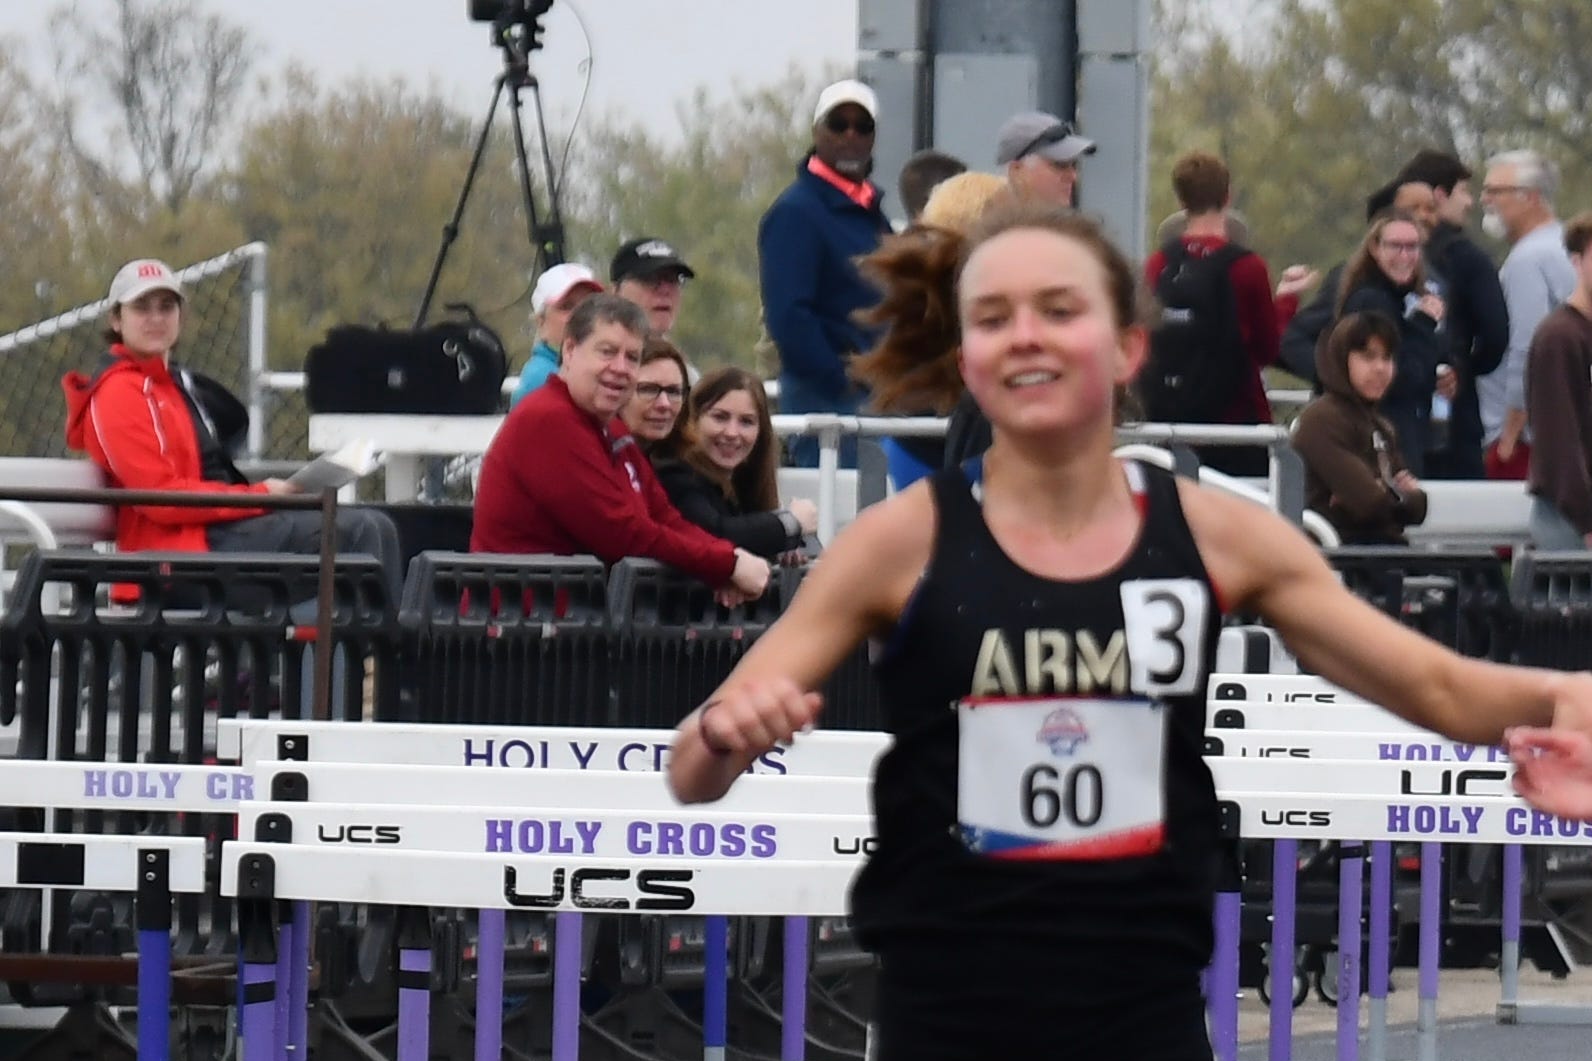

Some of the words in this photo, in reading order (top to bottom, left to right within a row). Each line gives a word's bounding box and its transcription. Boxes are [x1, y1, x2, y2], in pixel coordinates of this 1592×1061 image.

[1143, 591, 1185, 685] 3
[971, 628, 1129, 696] ARM
[463, 739, 598, 769] HOLY
[84, 770, 182, 800] HOLY
[1019, 763, 1104, 829] 60
[1401, 769, 1508, 796] UC
[1261, 810, 1332, 827] UCS
[1387, 805, 1484, 834] HOLY
[318, 824, 401, 844] UCS
[485, 819, 602, 854] HOLY
[627, 820, 777, 858] CROSS
[833, 836, 880, 855] UC
[503, 864, 696, 911] UCS
